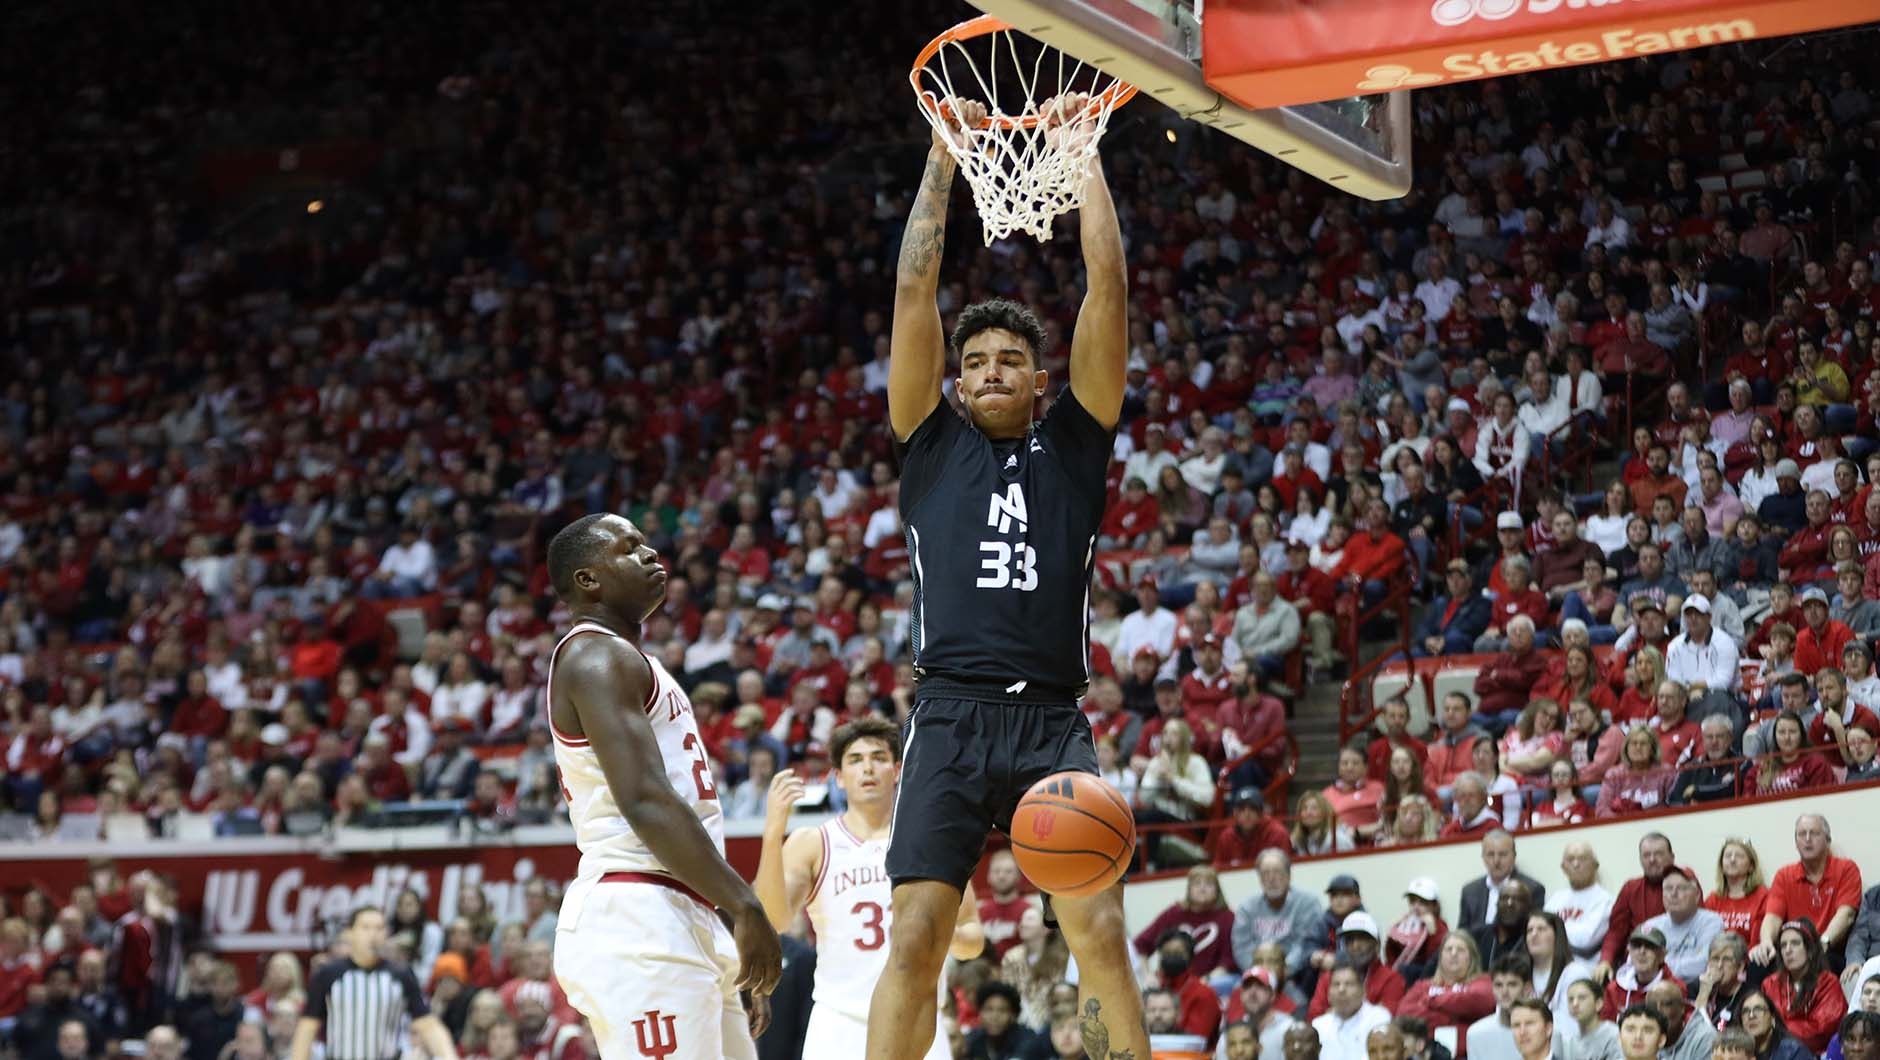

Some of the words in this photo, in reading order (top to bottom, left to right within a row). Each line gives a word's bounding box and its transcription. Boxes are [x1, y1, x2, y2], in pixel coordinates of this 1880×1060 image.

[976, 541, 1039, 592] 33
[202, 869, 260, 935] IU
[833, 865, 889, 897] INDI
[851, 901, 893, 952] 3
